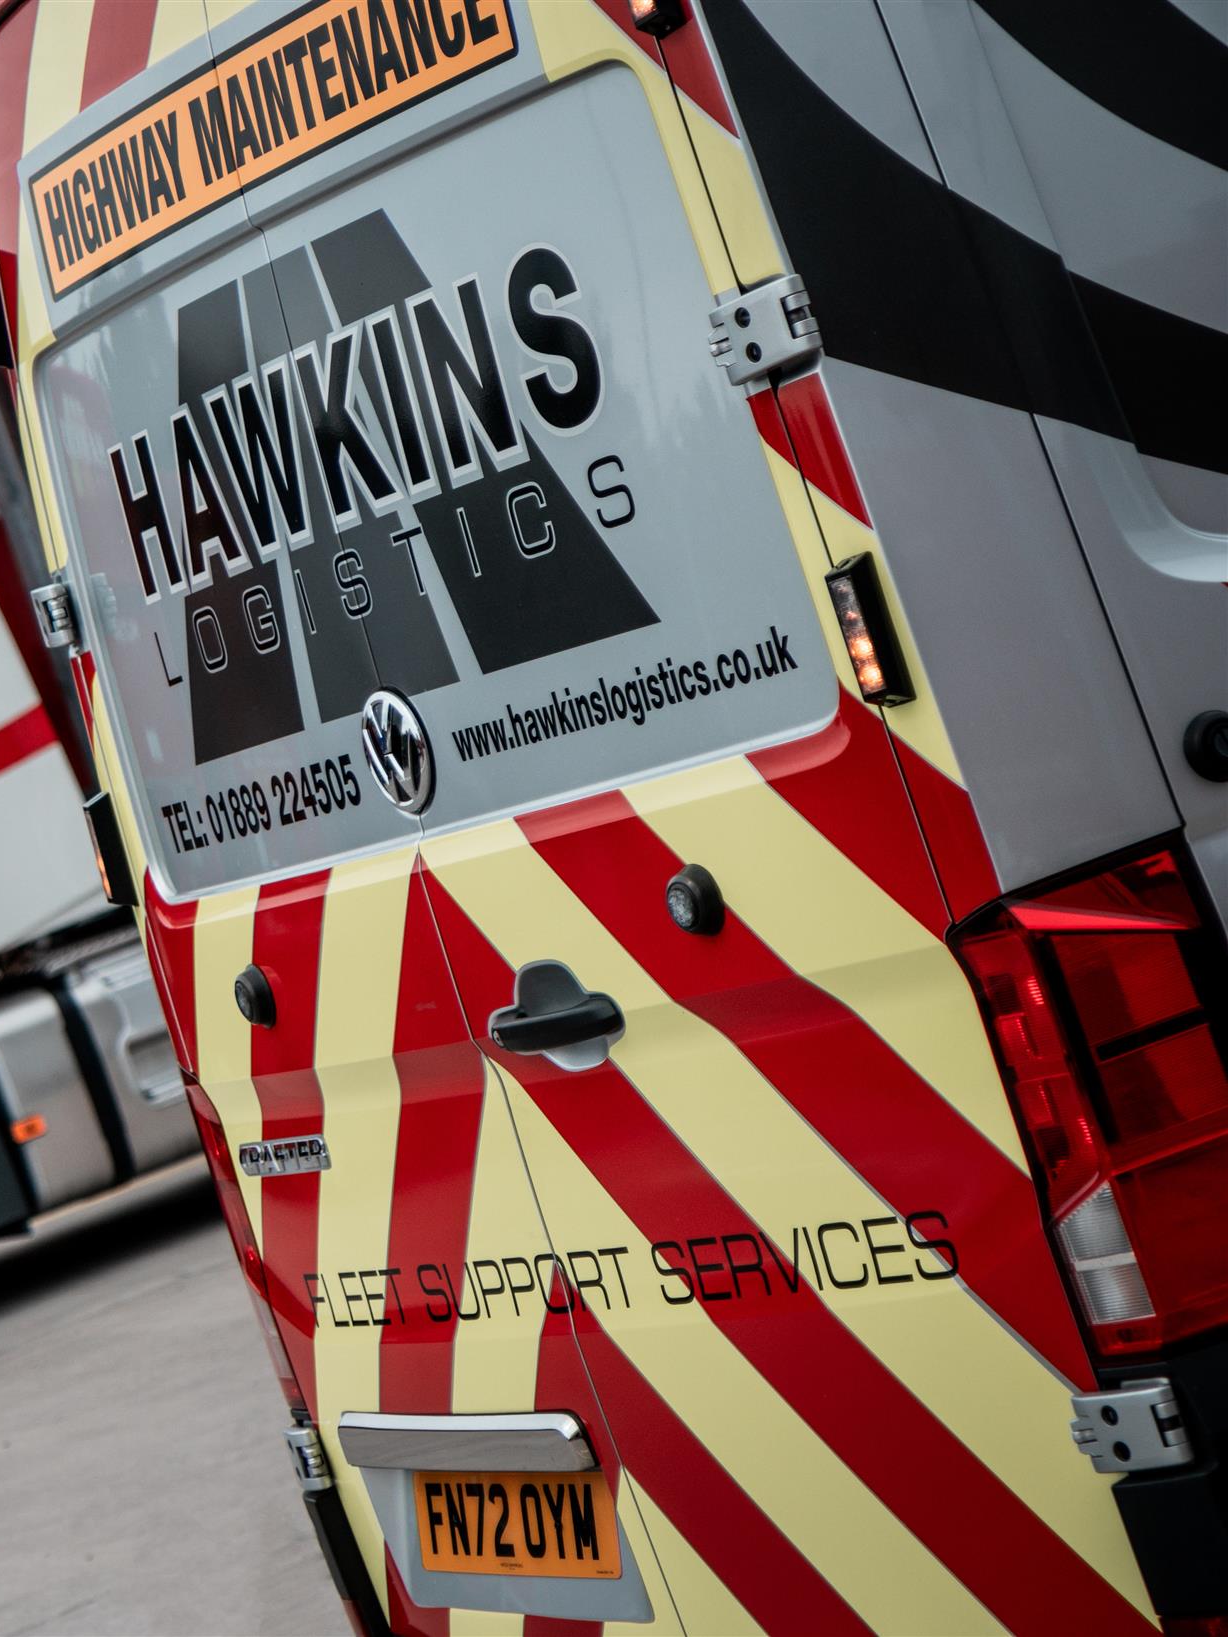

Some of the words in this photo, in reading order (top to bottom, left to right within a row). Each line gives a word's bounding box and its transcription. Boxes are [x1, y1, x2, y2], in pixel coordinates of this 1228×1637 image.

[43, 110, 185, 272] HIGHWAY
[188, 0, 500, 187] MAINTENANCE
[108, 241, 606, 606] HAWKINS
[153, 453, 637, 687] LOGISTICS
[451, 625, 798, 762] www.hawkinslogistics.co.uk
[162, 803, 208, 854] TEL:
[207, 784, 270, 847] 01889
[271, 753, 362, 827] 224505
[303, 1267, 406, 1329] FLEET
[419, 1246, 633, 1324] SUPPORT
[650, 1209, 961, 1306] SERVICES
[424, 1482, 516, 1558] FN72
[519, 1482, 600, 1561] OYM
